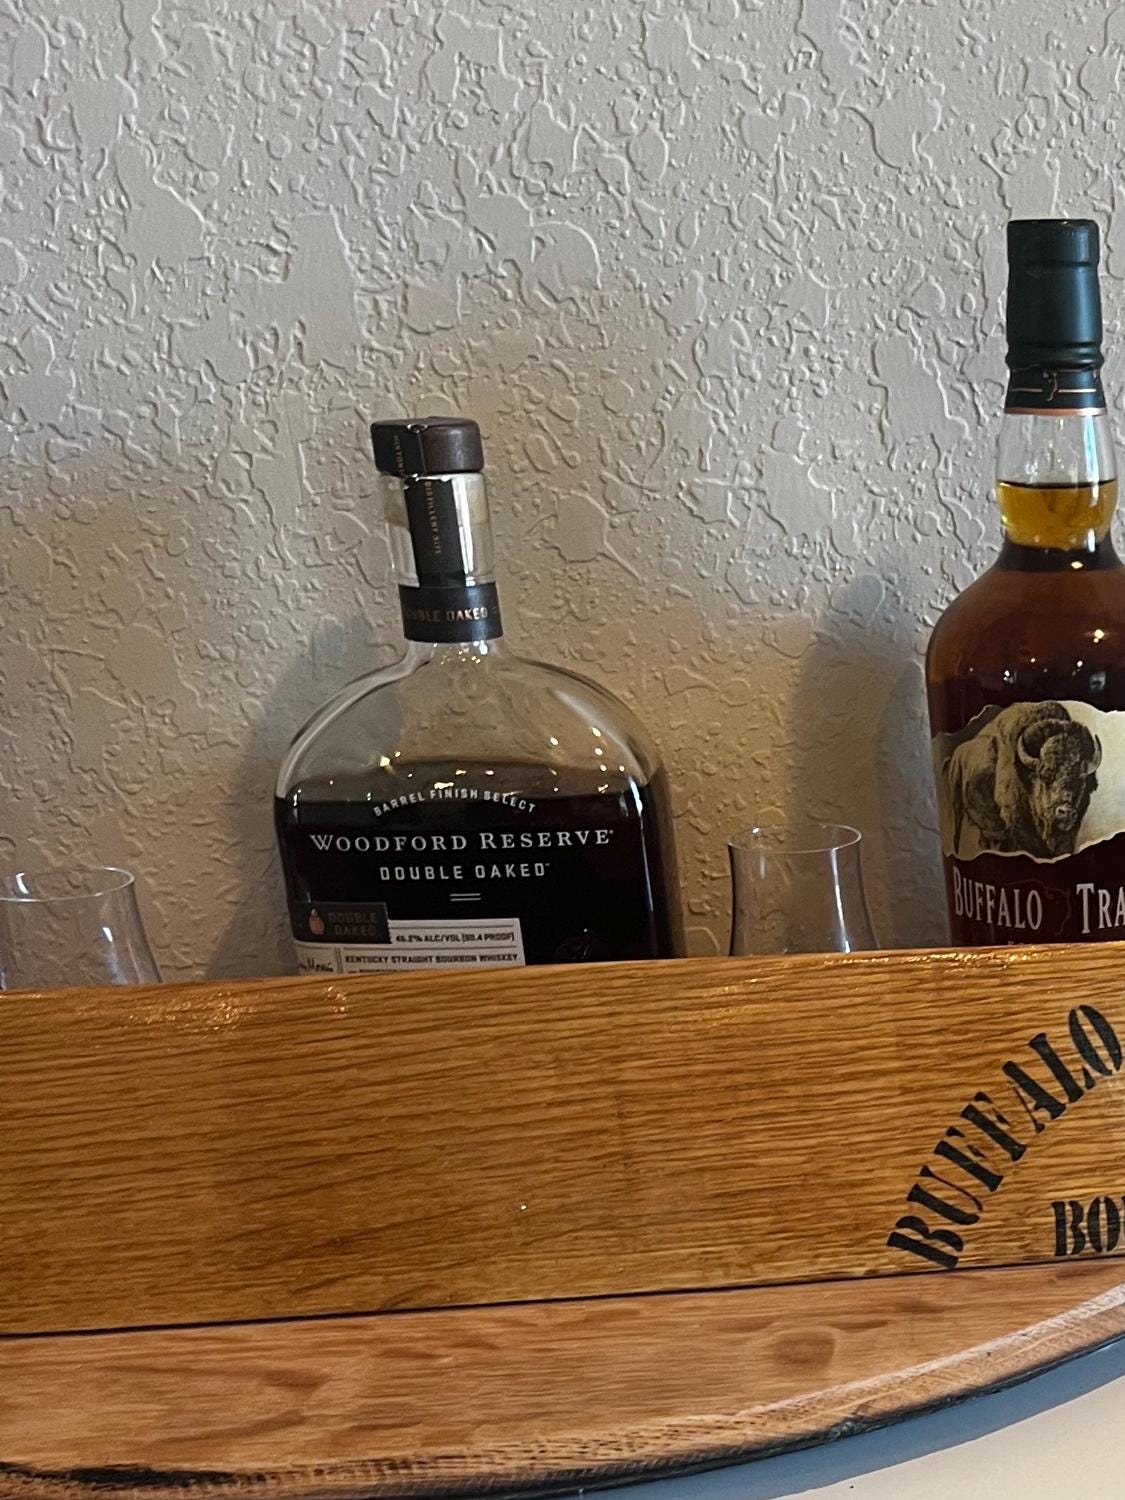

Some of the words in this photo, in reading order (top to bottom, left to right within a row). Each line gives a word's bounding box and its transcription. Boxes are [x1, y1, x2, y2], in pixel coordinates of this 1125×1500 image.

[446, 606, 488, 621] OAKED
[373, 792, 425, 817] BARREL
[430, 789, 478, 801] FINISH
[484, 789, 536, 813] SELECT
[309, 833, 467, 851] WOODFORD
[479, 829, 611, 849] RESERVE
[379, 866, 463, 881] DOUBLE
[475, 862, 546, 879] OAKED
[952, 865, 1043, 930] BUFFALO
[328, 911, 378, 925] DOUBLE
[335, 924, 377, 936] OAKED
[345, 955, 388, 964] KENTUCKY
[391, 954, 433, 964] STRAIGHT
[435, 954, 478, 963] BOURBON
[480, 953, 518, 962] WHISKEY
[886, 1004, 1122, 1271] BUFFALO
